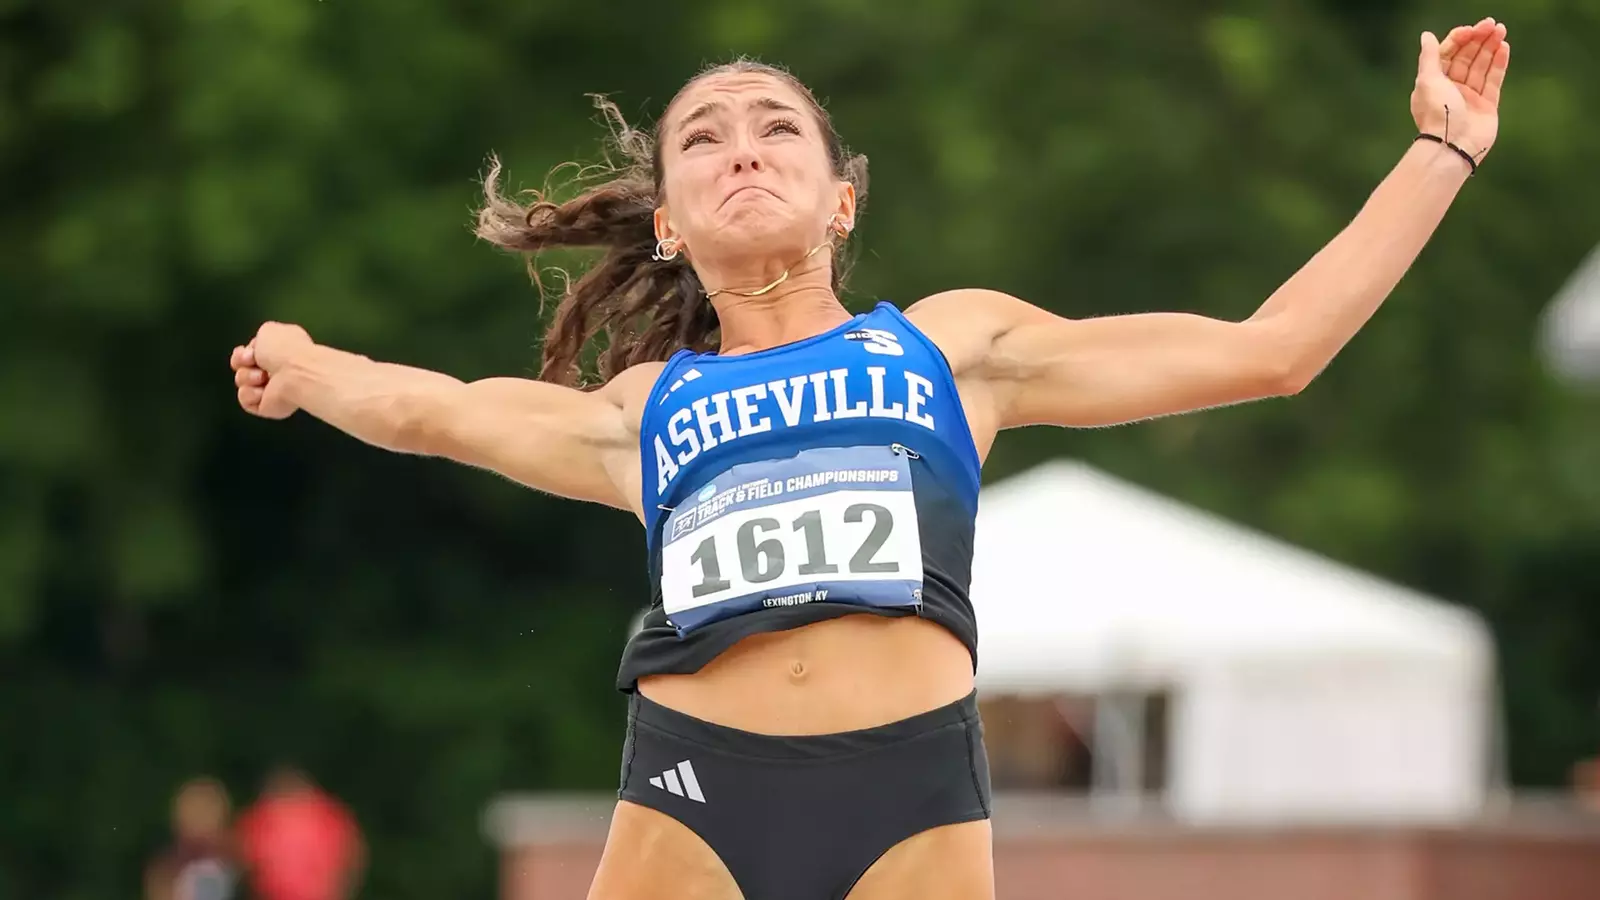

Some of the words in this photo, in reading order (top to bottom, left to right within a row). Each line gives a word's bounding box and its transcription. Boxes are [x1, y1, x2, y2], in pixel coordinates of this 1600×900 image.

[653, 366, 935, 496] ASHEVILLE
[697, 493, 735, 520] TRACK
[735, 490, 746, 503] &
[747, 480, 783, 501] FIELD
[786, 469, 899, 493] CHAMPIONSHIPS
[690, 503, 900, 598] 1612
[815, 590, 828, 601] KY
